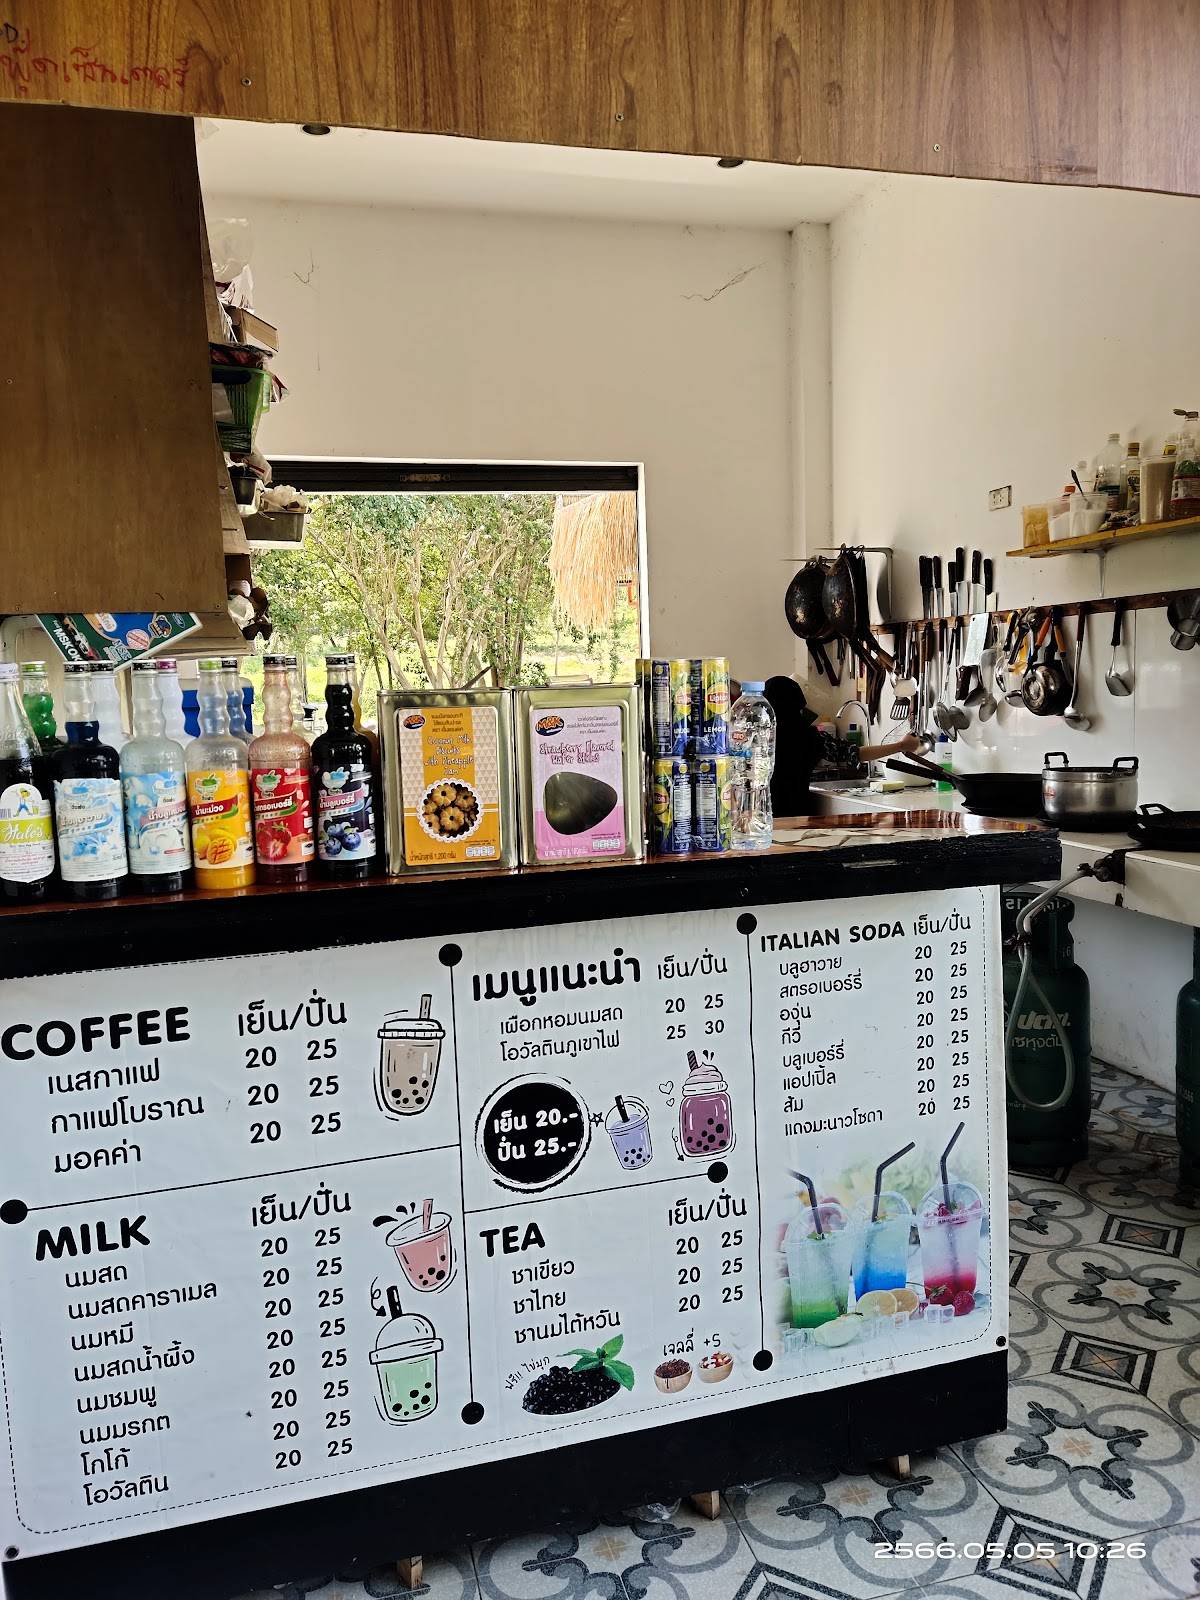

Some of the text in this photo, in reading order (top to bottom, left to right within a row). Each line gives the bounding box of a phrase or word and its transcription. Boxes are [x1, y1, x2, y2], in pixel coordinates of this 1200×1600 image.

[760, 927, 840, 953] ITALIAN
[849, 920, 905, 943] SODA
[913, 907, 972, 936] เย็น/ปั่น
[472, 947, 728, 1007] เมนูแนะนำ เย็น/ปั่น
[779, 940, 967, 979] บลูฮาวาย 20 25
[779, 962, 967, 999] สตรอเบอร์รี่ 20 25
[0, 988, 348, 1061] COFFEE เย็น/ปั่น
[500, 993, 724, 1035] เผือกหอมนมสด 20 25
[779, 984, 968, 1026] องุ่น 20 25
[917, 1012, 934, 1028] 20
[950, 1007, 969, 1022] 25
[48, 1038, 337, 1095] เนสกาแฟ 20 25
[500, 1019, 725, 1062] โอวัลตินภูเขาไฟ 25 30
[782, 1029, 969, 1071] บลูเบอร์รี่ 20 25
[783, 1051, 969, 1091] แอปเปิ้ล 20 25
[783, 1073, 970, 1113] ส้ม 20 25
[51, 1075, 339, 1134] กาแฟโบราณ 20 25
[494, 1109, 578, 1133] เย็น 20.-
[918, 1100, 936, 1116] 20
[953, 1095, 970, 1111] 25
[54, 1111, 341, 1174] มอคค่า 20 25
[497, 1136, 577, 1162] ปั่น 25.-
[35, 1181, 352, 1262] MILK เย็น/ปั่น
[479, 1187, 748, 1258] TEA เย็น/ปั่น
[65, 1226, 341, 1288] นมสด 20 25
[511, 1229, 743, 1285] ชาเขียว 20 25
[68, 1256, 343, 1320] นมสดคาราเมล 20 25
[513, 1257, 743, 1315] ชาไทย 20 25
[514, 1285, 744, 1344] ชานมไต้หวัน 20 25
[71, 1287, 344, 1351] นมหมี 20 25
[663, 1327, 721, 1356] เจลลี่ +5
[74, 1317, 346, 1382] นมสดน้ำผึ้ง 20 25
[76, 1348, 348, 1414] นมชมพู 20 25
[79, 1379, 349, 1445] นมมรกต 20 25
[80, 1409, 351, 1476] โกโก้ 20 25
[82, 1437, 353, 1506] โอวัลติน 20 25
